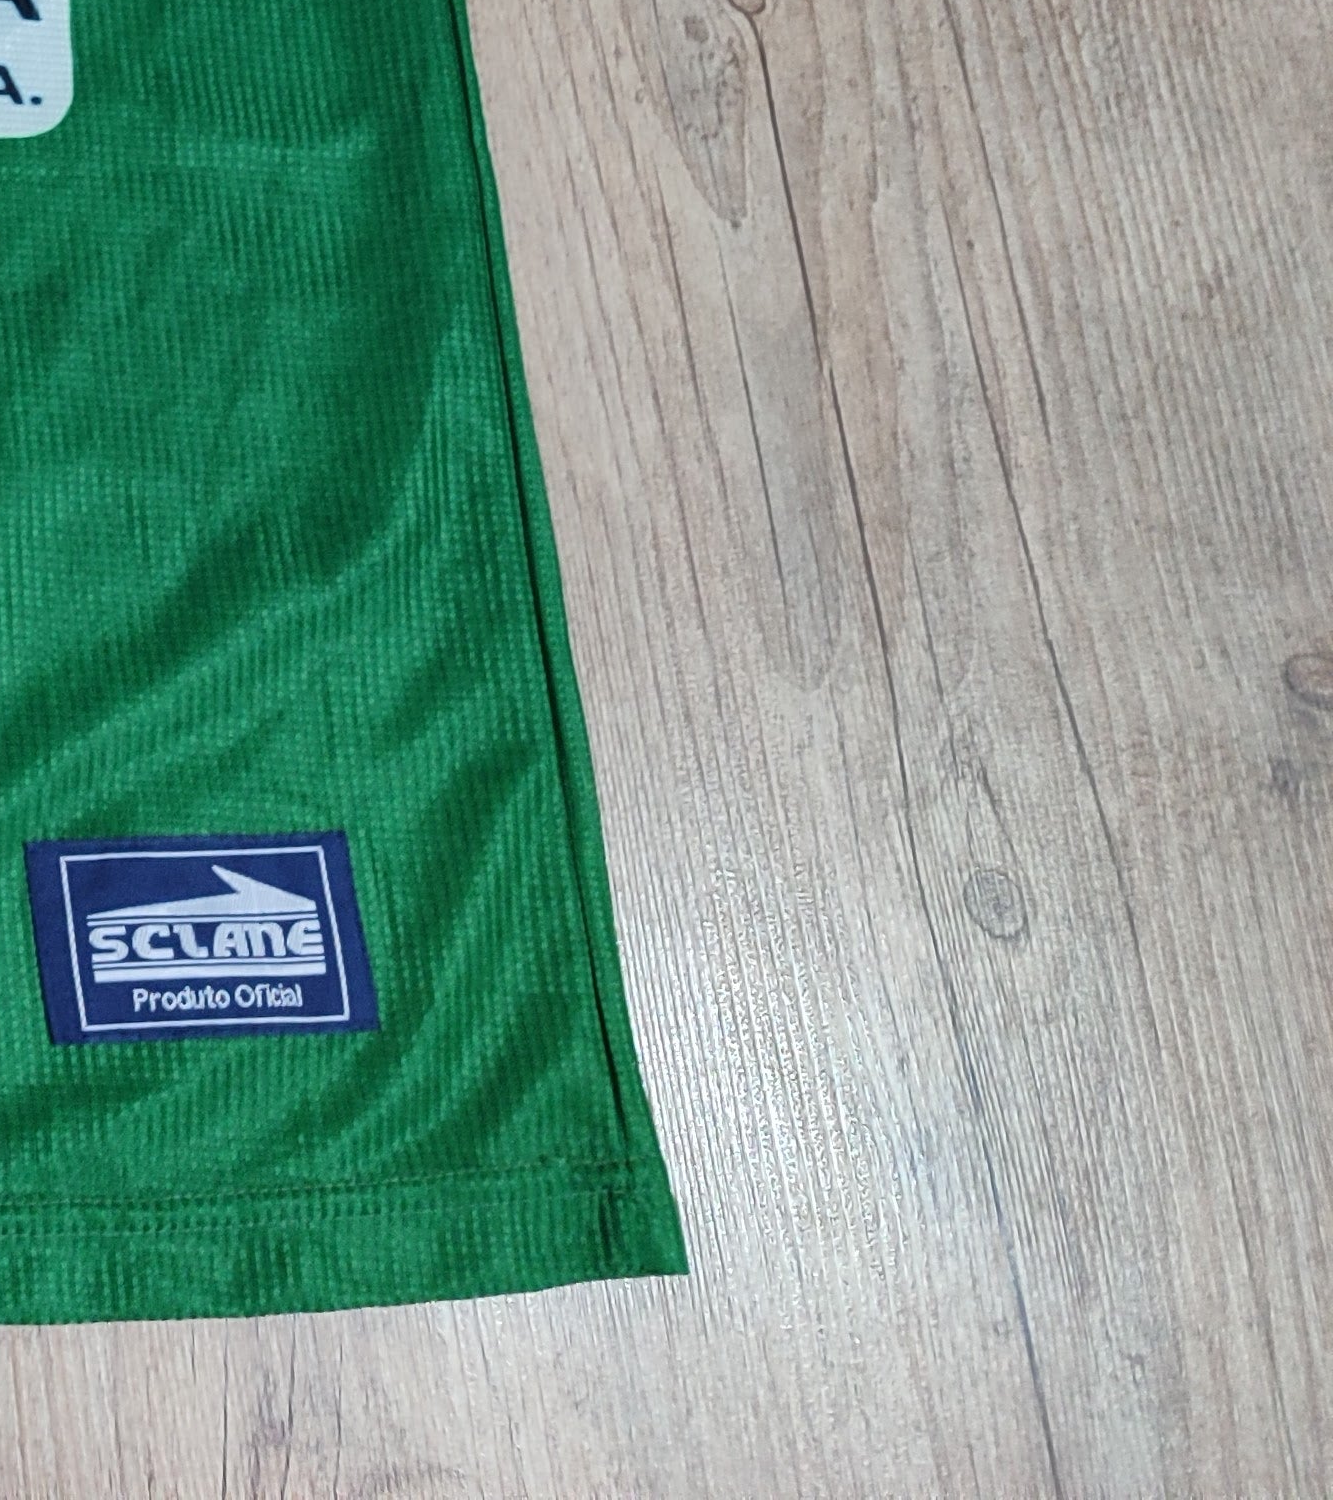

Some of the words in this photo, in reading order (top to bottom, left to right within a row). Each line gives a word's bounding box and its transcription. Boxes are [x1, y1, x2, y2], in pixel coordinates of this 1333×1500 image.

[88, 919, 325, 963] SCLANE
[133, 985, 231, 1012] Produto
[234, 982, 303, 1008] Oficial
